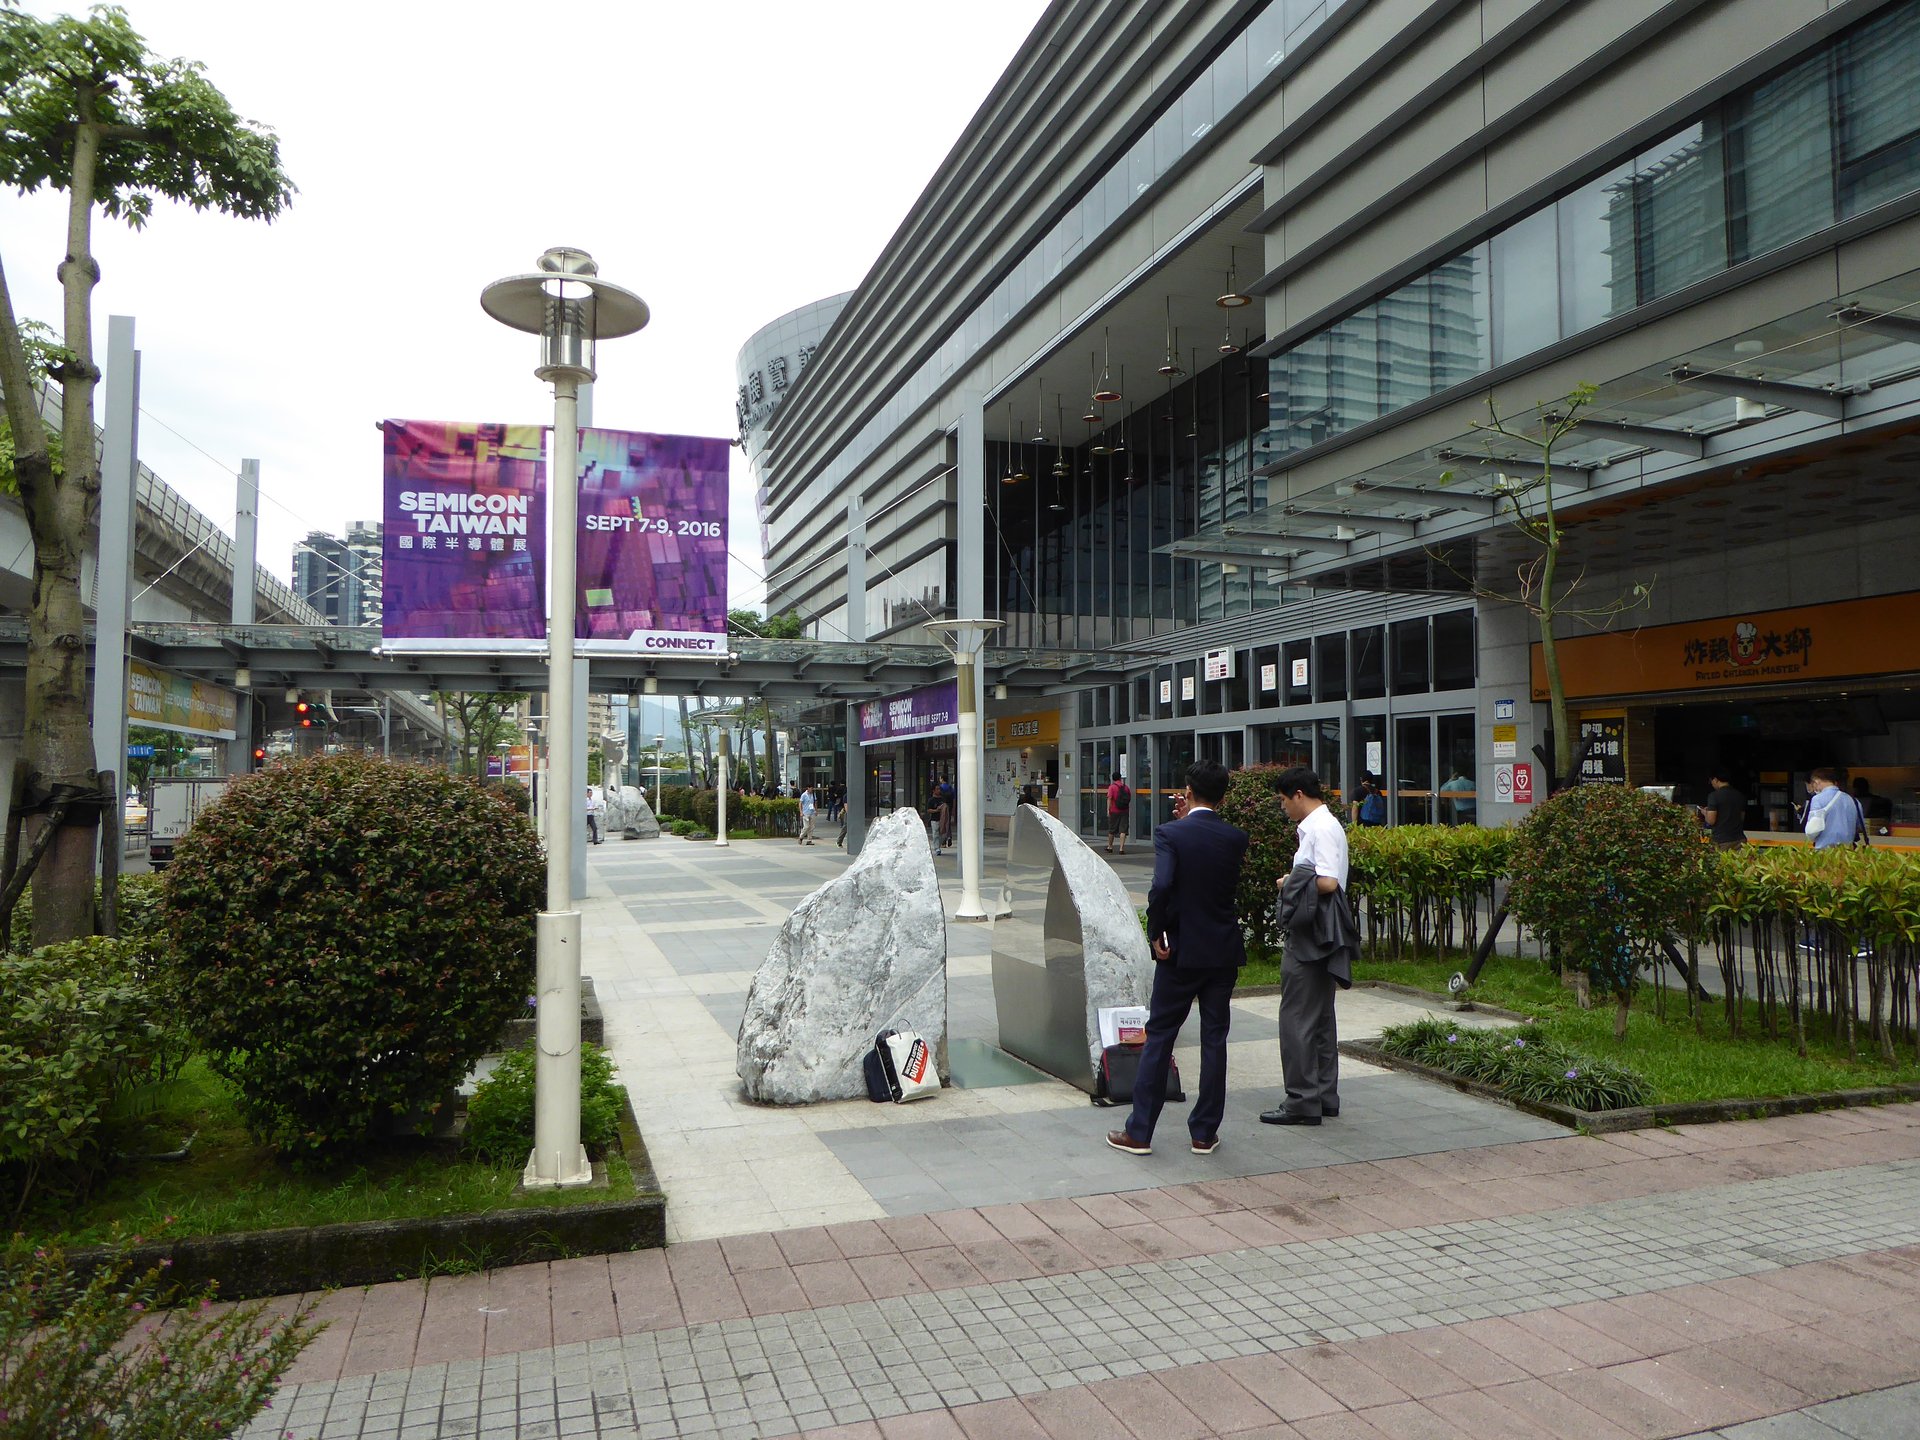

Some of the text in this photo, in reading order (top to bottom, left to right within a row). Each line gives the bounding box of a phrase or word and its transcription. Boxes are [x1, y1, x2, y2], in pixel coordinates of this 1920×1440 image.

[399, 491, 528, 515] SEMICON
[412, 513, 527, 536] TAIWAN
[585, 514, 721, 538] SEPT 7-9, 2016
[399, 535, 527, 552] 國際半導體展
[645, 636, 716, 651] CONNECT
[1760, 663, 1801, 677] MASTER
[130, 672, 162, 697] SEMICON
[133, 692, 161, 715] TAIWAN
[889, 698, 913, 717] SEMICON
[891, 713, 912, 731] TAIWAN
[931, 713, 941, 724] SEPT
[909, 1045, 925, 1079] DUTY FREE
